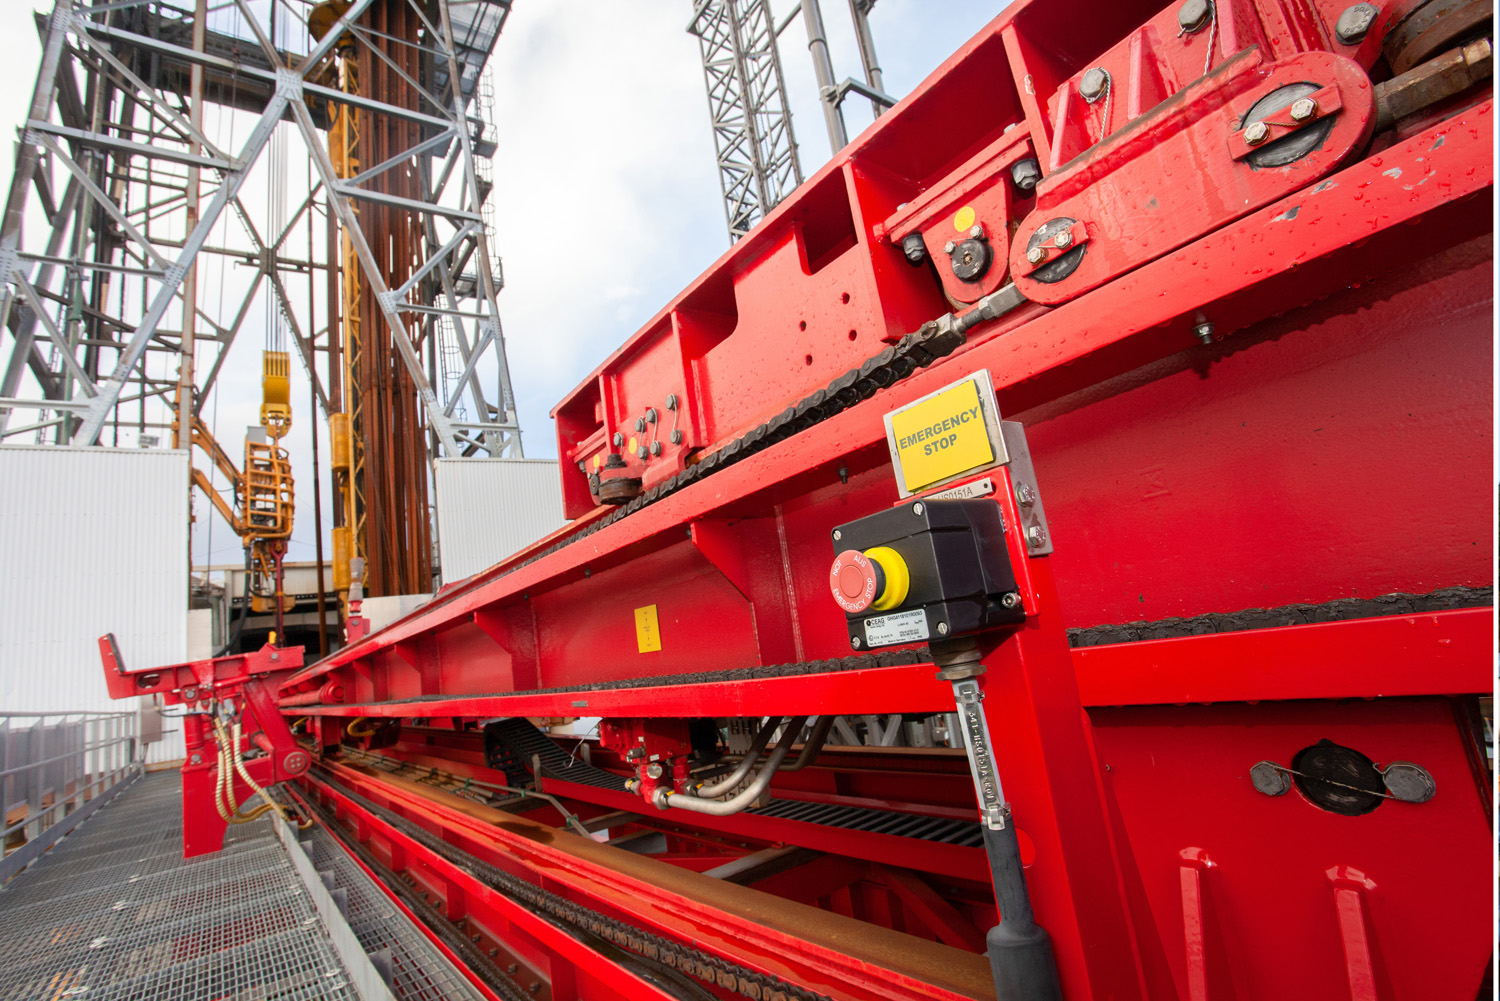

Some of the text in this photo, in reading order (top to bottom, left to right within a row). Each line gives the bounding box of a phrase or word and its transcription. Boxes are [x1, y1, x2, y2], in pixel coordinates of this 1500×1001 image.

[899, 406, 978, 450] EMERGENCY
[923, 433, 957, 456] STOP
[832, 555, 867, 576] NOT AUS
[833, 577, 874, 610] EMERGENCY STOP
